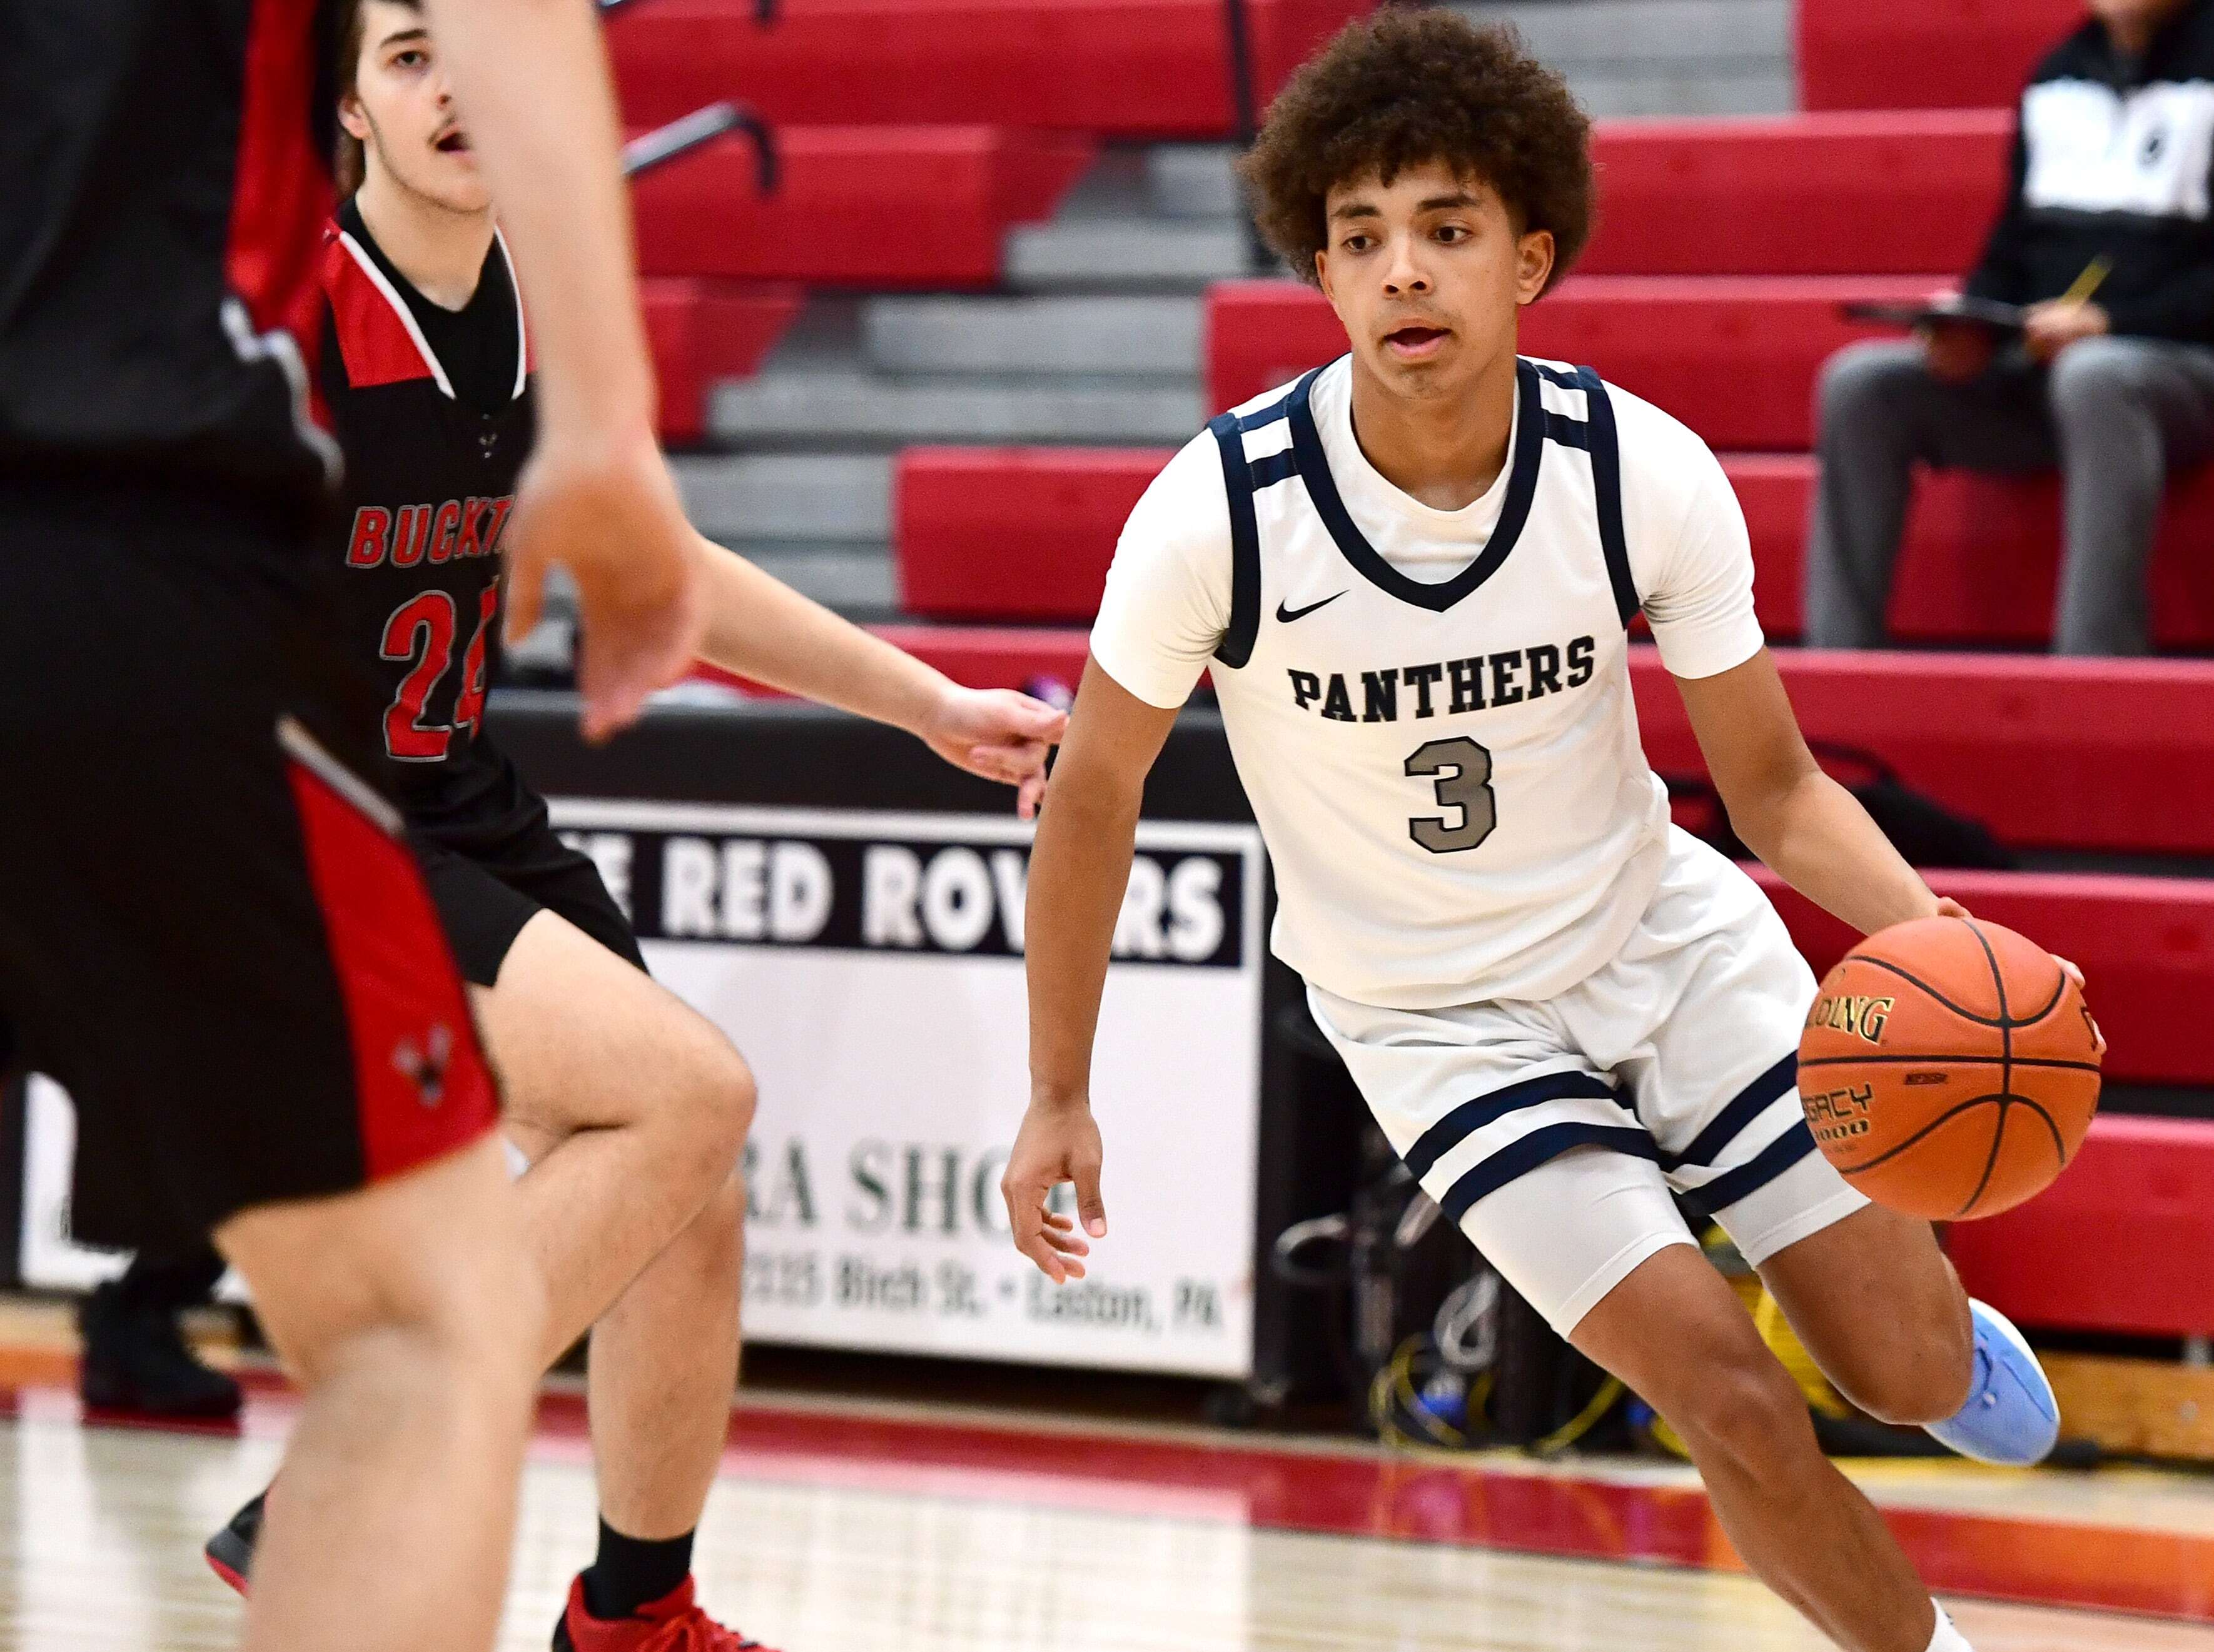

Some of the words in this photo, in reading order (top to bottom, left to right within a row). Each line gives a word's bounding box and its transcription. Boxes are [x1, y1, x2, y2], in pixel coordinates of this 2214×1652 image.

[1286, 635, 1595, 723] PANTHERS
[1404, 735, 1497, 854] 3
[660, 835, 834, 944] RED
[862, 842, 1225, 963] ROVRS
[846, 1137, 1077, 1242] SHO
